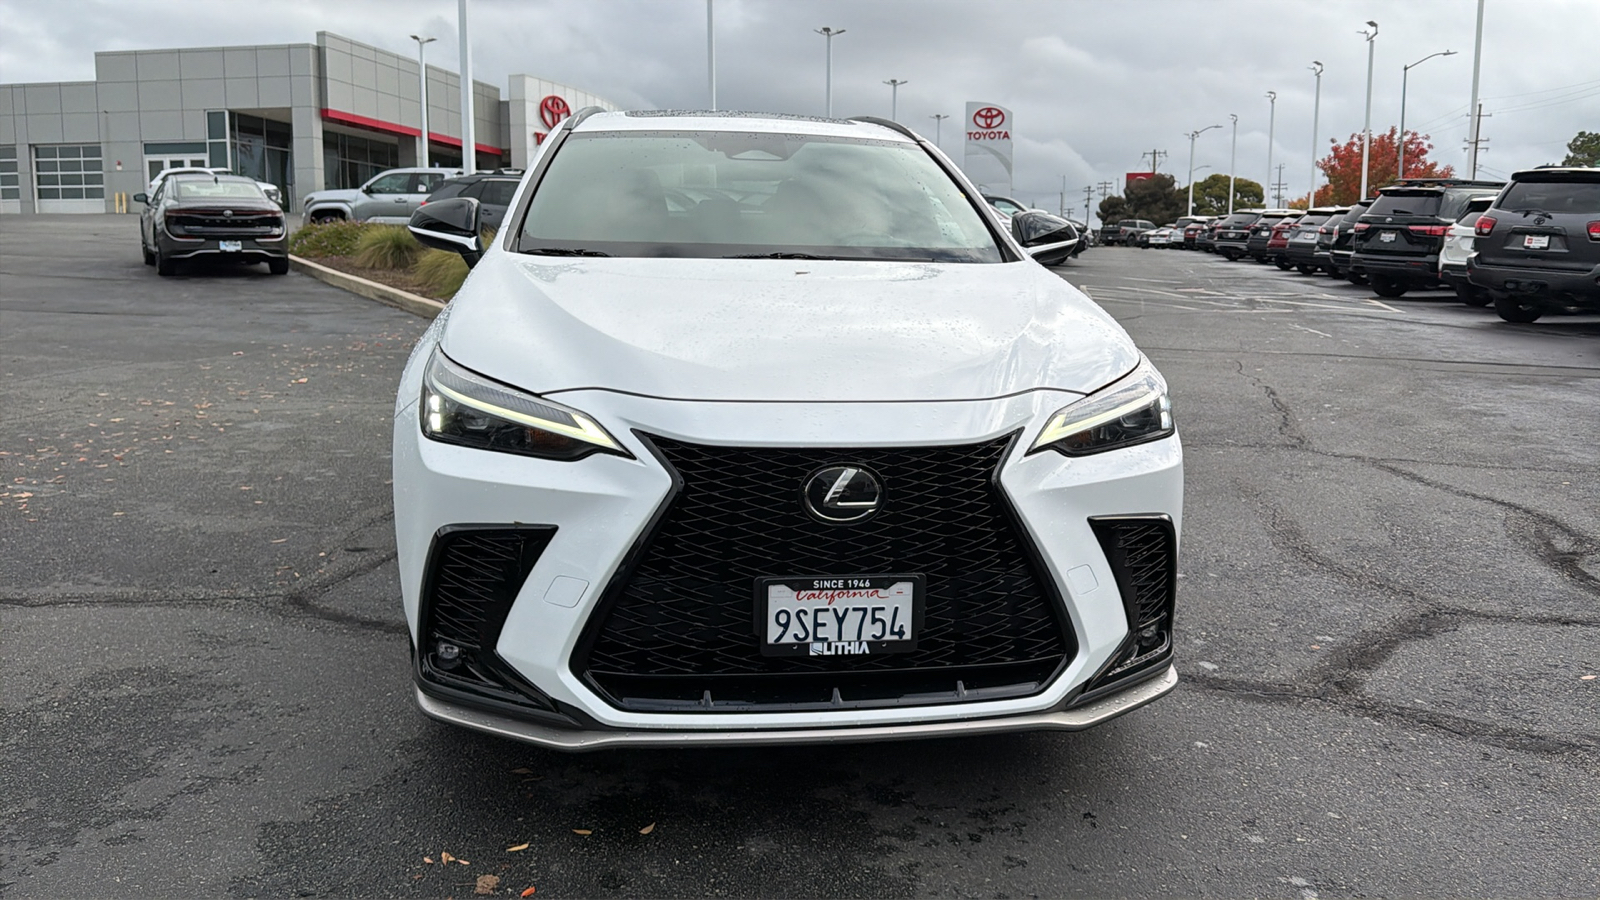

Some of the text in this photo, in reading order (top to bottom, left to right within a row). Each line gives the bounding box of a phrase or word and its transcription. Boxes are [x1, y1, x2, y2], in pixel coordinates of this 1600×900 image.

[967, 131, 1010, 140] TOYOTA
[813, 579, 870, 588] SINCE 1946
[796, 589, 889, 605] California
[774, 606, 906, 643] 9SEY754
[823, 641, 870, 655] LITHIA
